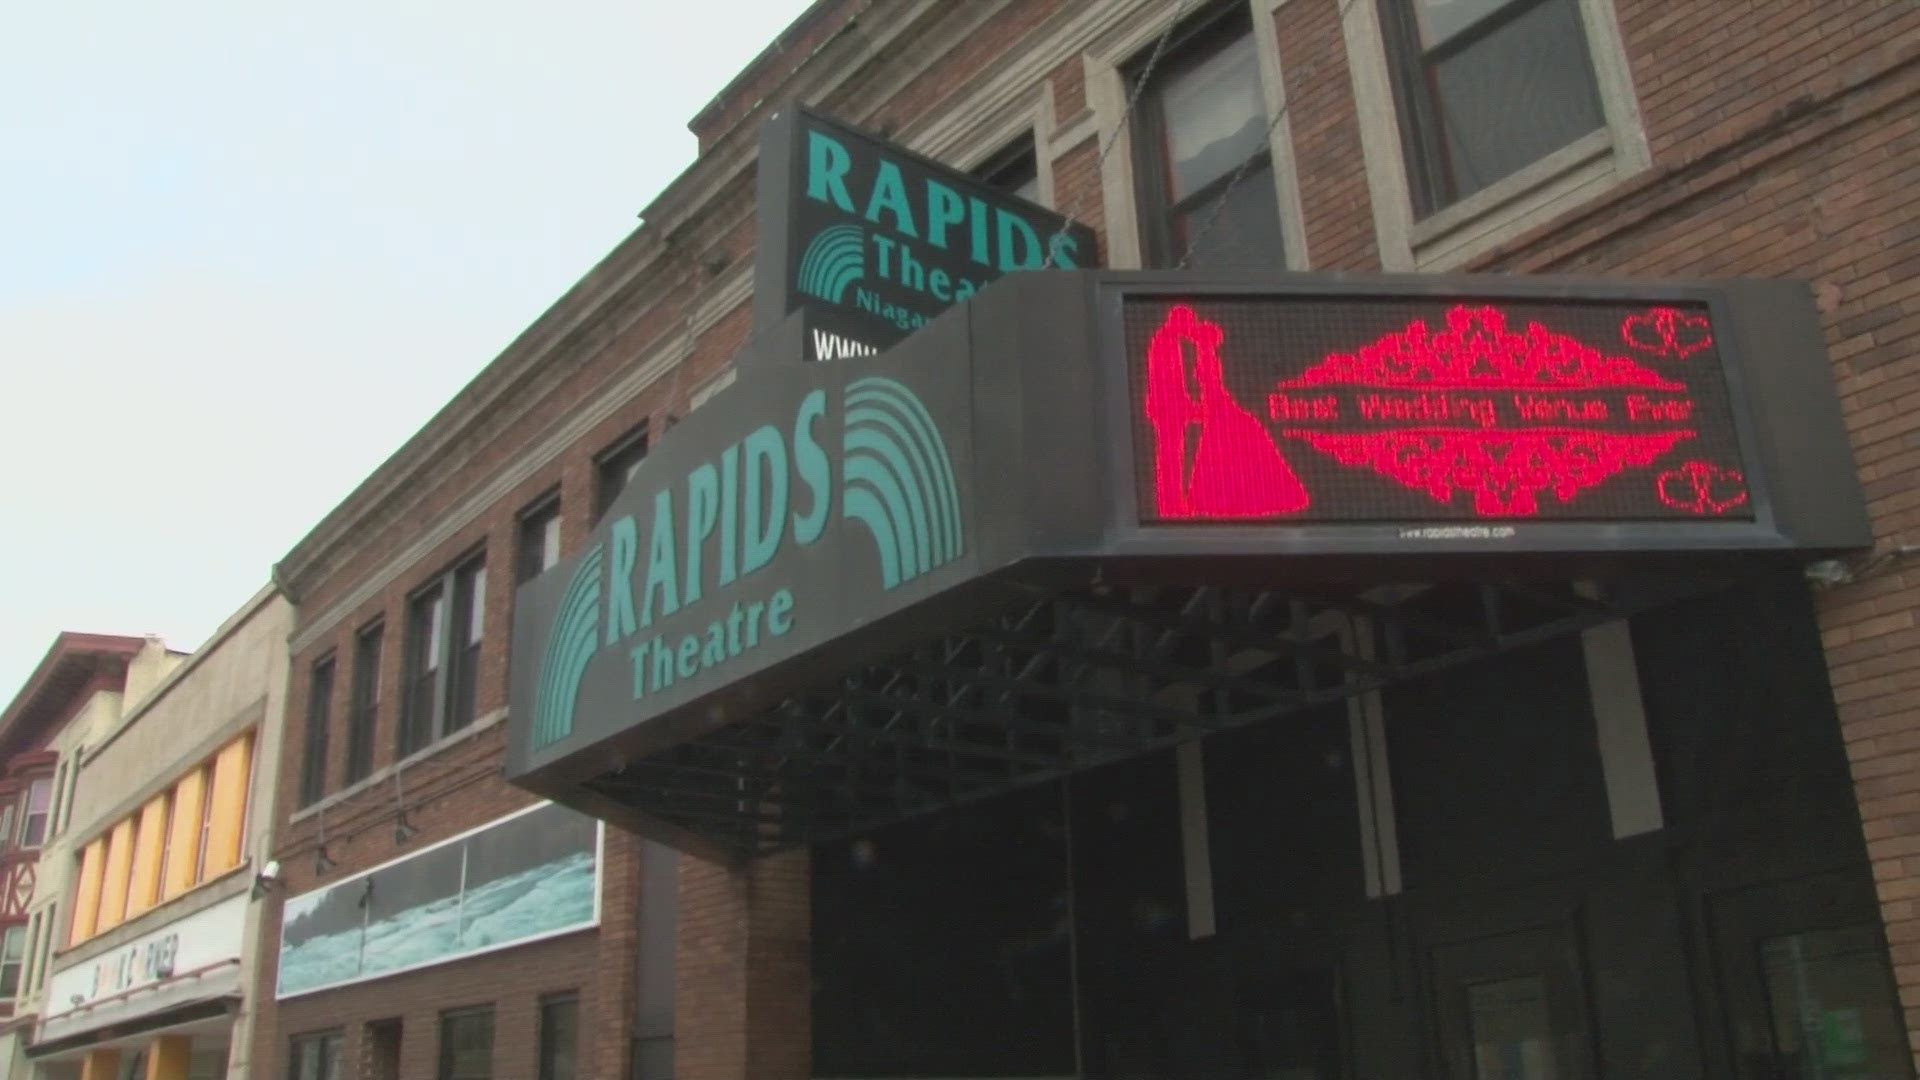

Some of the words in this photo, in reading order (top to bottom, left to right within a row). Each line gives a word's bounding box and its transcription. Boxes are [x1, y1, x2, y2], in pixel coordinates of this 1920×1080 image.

[807, 129, 1078, 271] RAPIDS
[872, 233, 988, 303] Thea
[1357, 394, 1497, 428] Wedding
[1514, 395, 1609, 421] Venue
[606, 389, 831, 646] RAPIDS
[630, 588, 795, 700] Theatre
